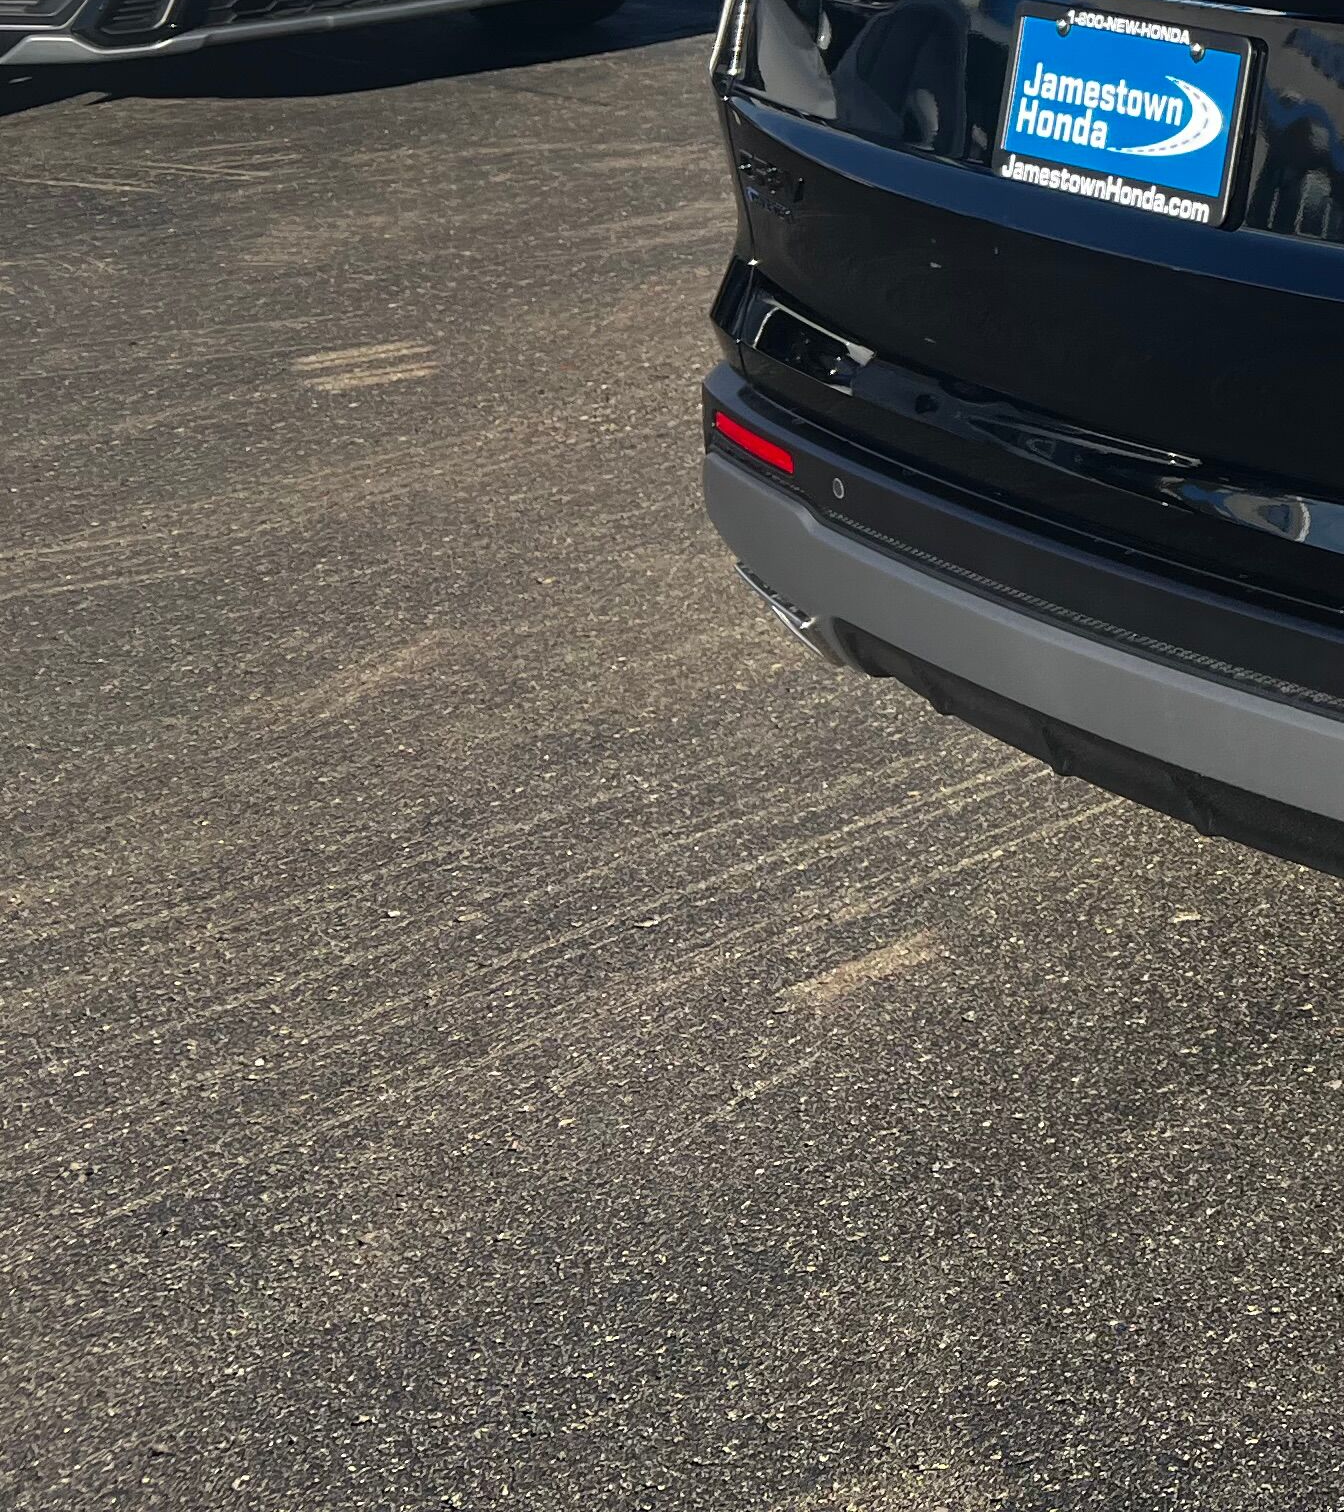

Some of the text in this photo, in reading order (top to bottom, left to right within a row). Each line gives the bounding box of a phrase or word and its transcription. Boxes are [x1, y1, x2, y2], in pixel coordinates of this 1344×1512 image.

[1067, 9, 1190, 45] 1-800-NEW-HONDA
[1016, 97, 1108, 149] Honda
[1023, 62, 1184, 126] Jamestown
[1001, 153, 1210, 223] JamestownHonda.com
